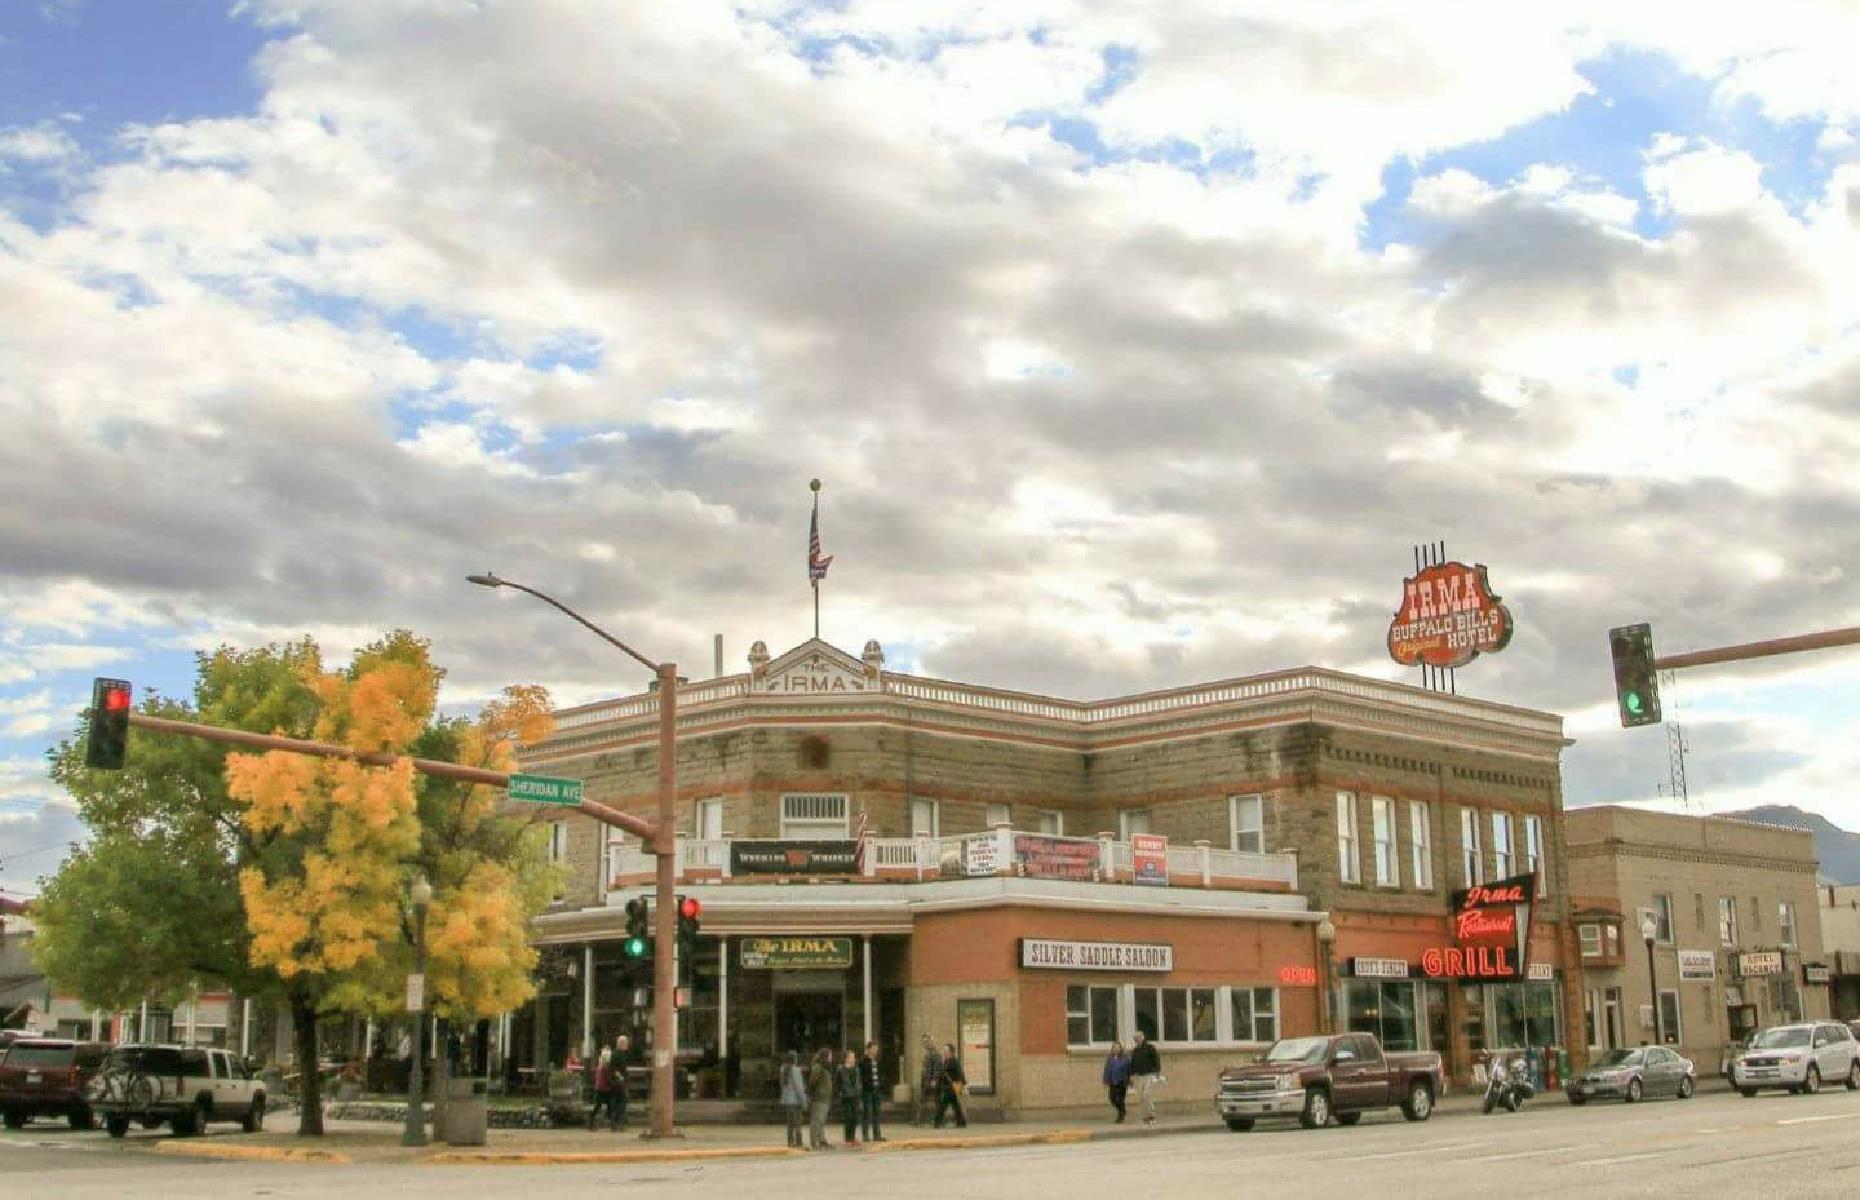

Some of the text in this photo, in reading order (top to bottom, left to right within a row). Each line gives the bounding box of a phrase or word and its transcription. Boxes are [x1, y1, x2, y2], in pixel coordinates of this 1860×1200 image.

[1407, 572, 1480, 621] IRMA
[1393, 618, 1453, 641] BUFFALO
[1447, 627, 1497, 649] HOTEL
[784, 674, 846, 691] IRMA
[510, 779, 581, 800] SHERIDAN AVE
[782, 938, 838, 953] IRMA
[1031, 943, 1167, 967] SILVER SADDLE SALOON
[1422, 946, 1514, 976] GRILL
